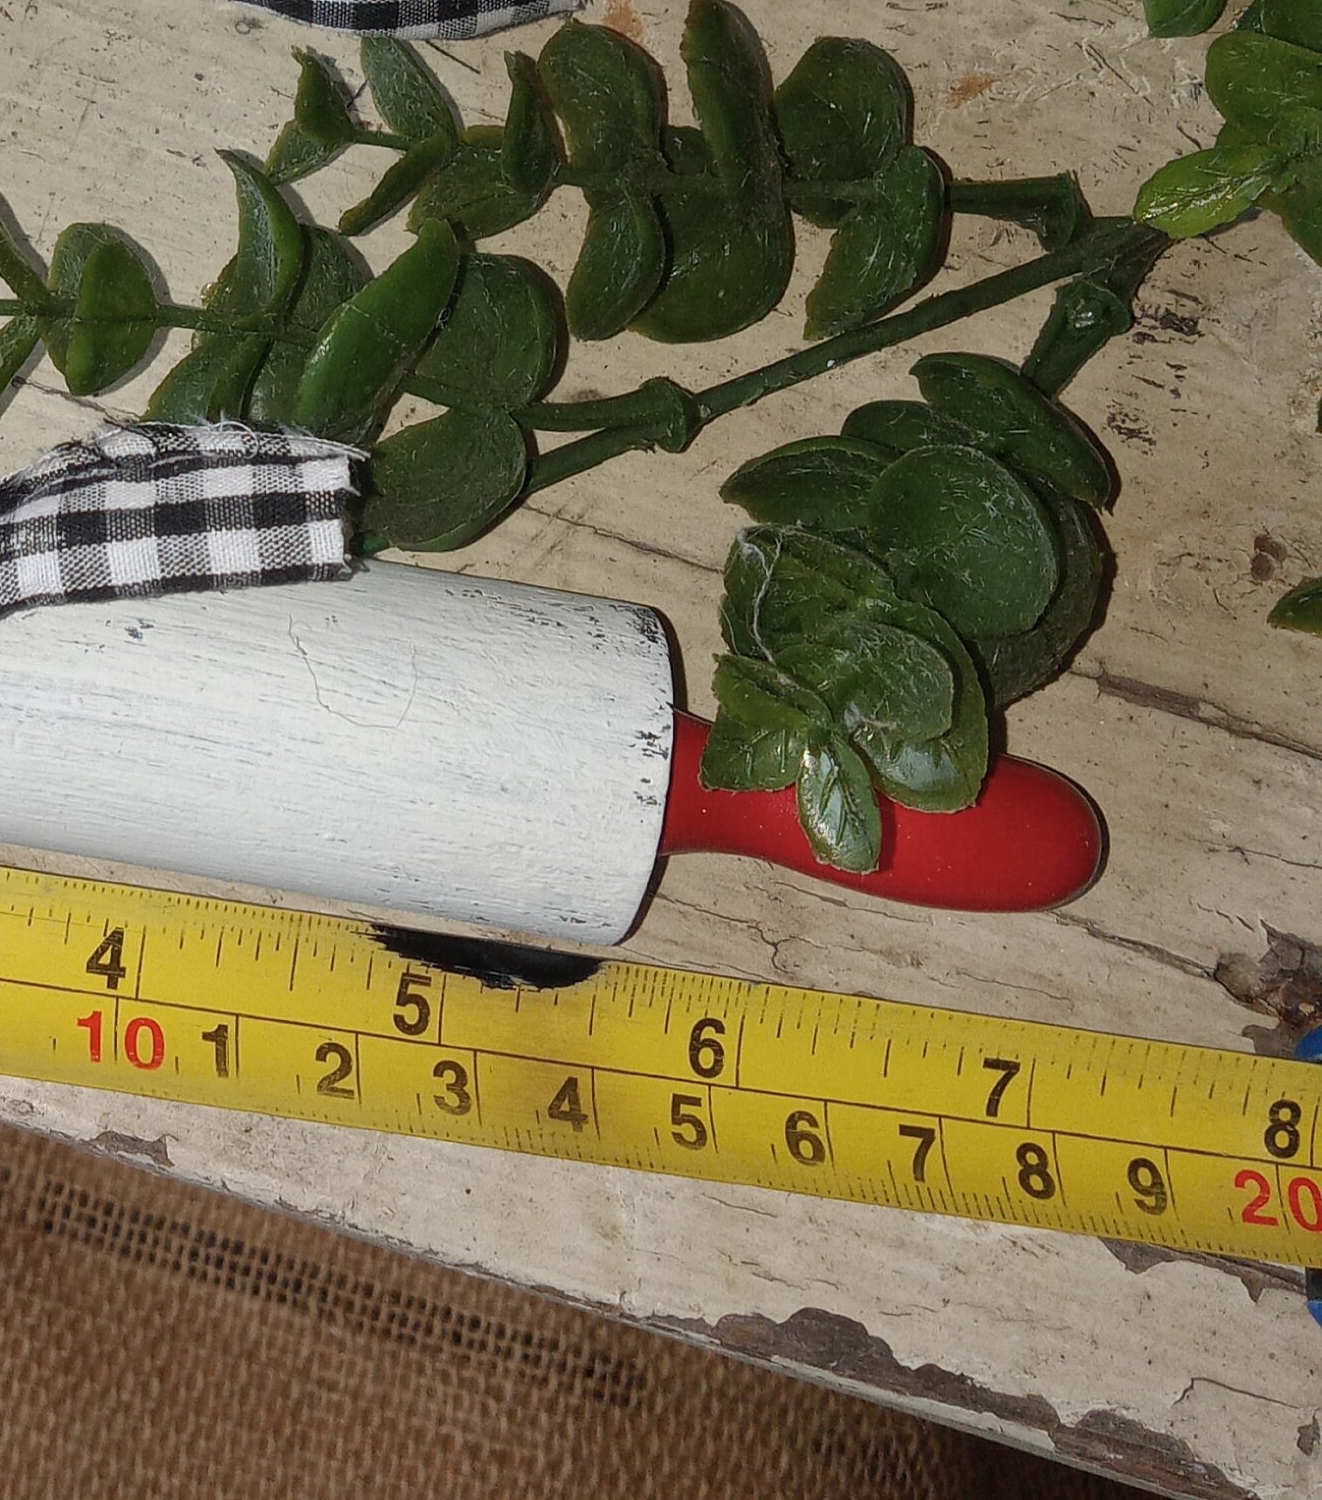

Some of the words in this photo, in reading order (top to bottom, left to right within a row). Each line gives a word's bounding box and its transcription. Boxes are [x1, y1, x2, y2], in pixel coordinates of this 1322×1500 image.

[76, 1009, 166, 1071] 10
[201, 1022, 231, 1079] 1
[314, 1041, 357, 1100] 2
[431, 1058, 472, 1117] 3
[546, 1075, 589, 1133] 4
[669, 1092, 709, 1151] 5
[784, 1108, 827, 1167] 6
[897, 1124, 937, 1184] 7
[1014, 1141, 1057, 1201] 8
[1125, 1156, 1169, 1217] 9
[1232, 1168, 1321, 1233] 20
[84, 926, 127, 990] 4
[392, 971, 433, 1036] 5
[687, 1017, 726, 1079] 6
[981, 1056, 1022, 1118] 7
[1263, 1099, 1303, 1160] 8
